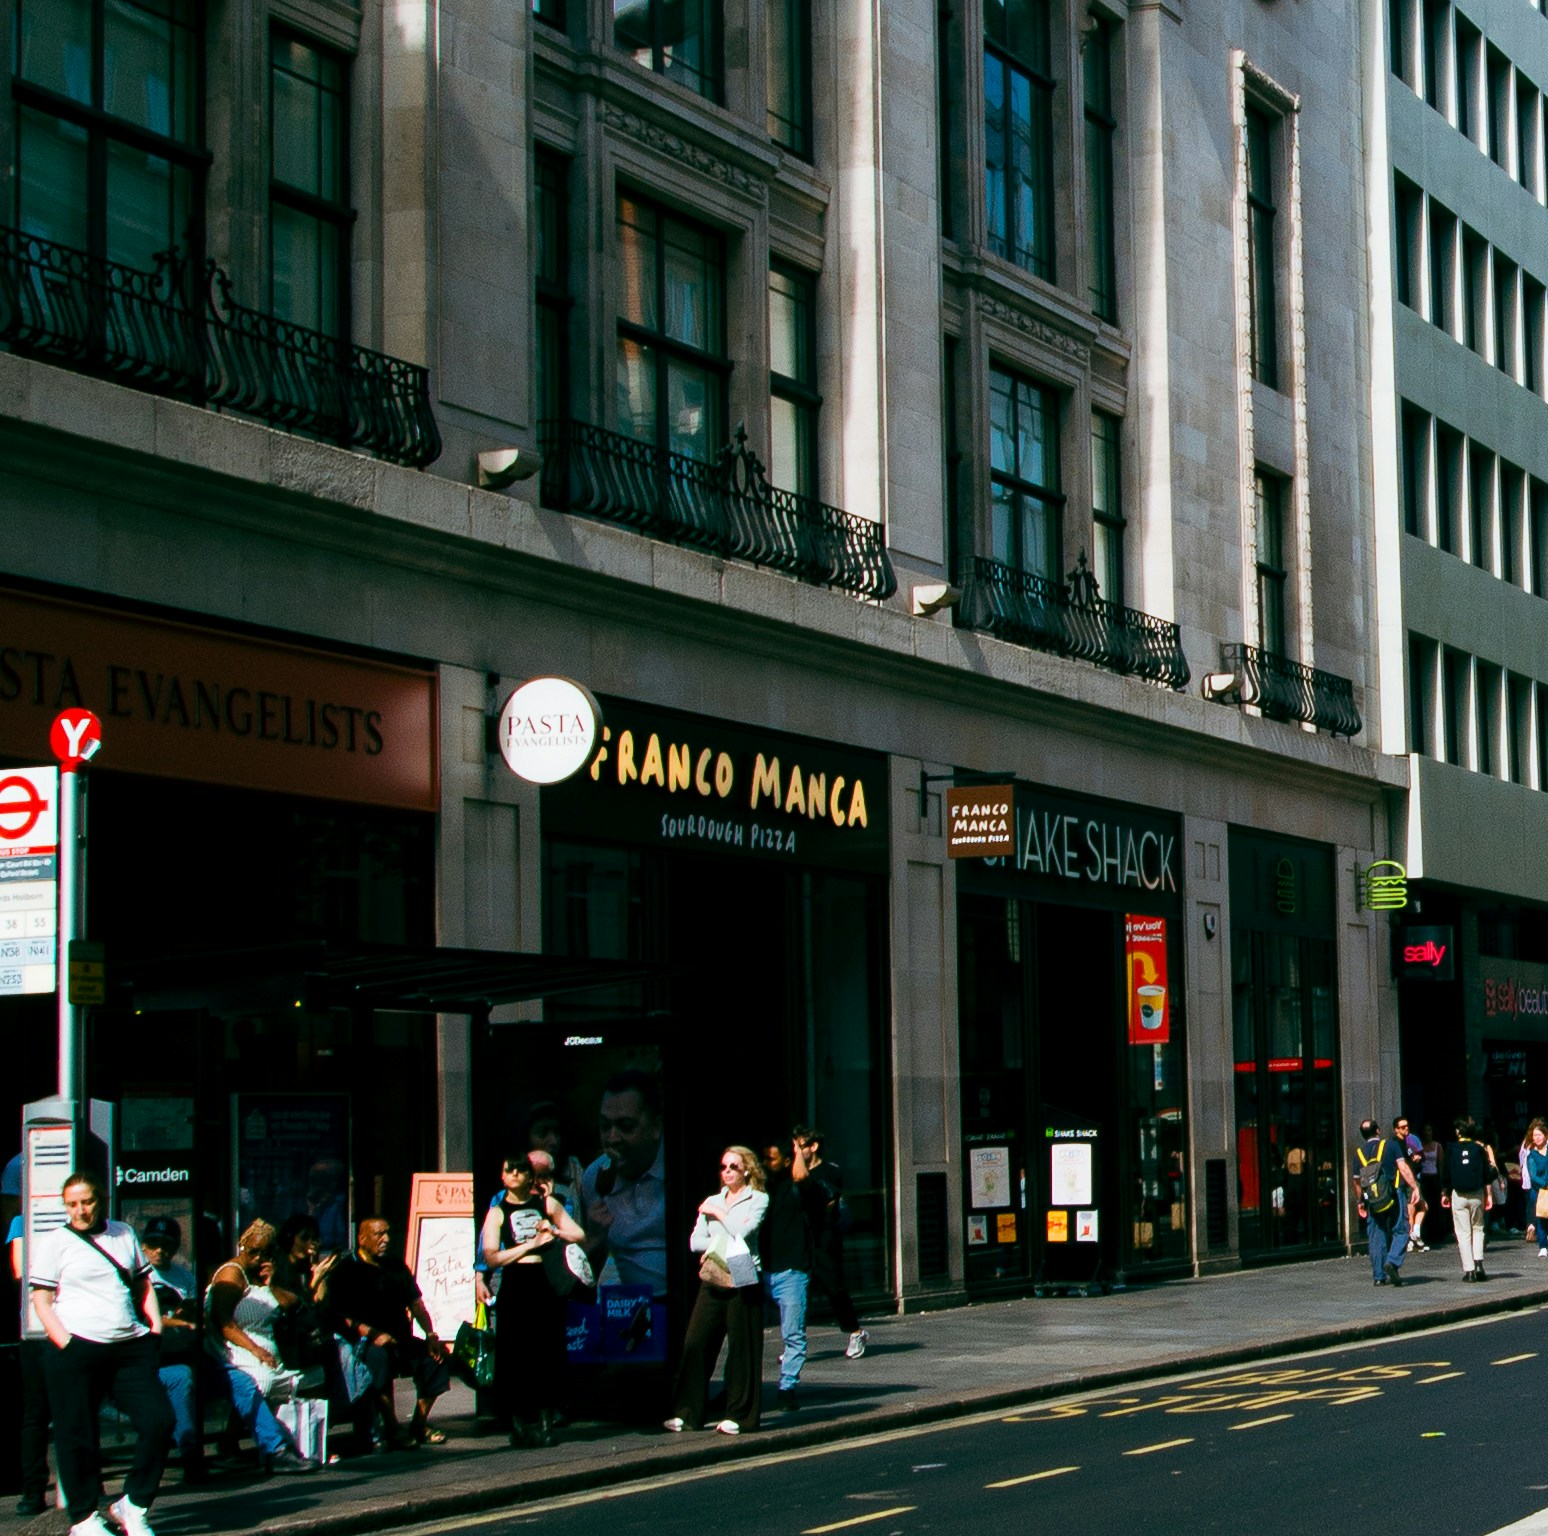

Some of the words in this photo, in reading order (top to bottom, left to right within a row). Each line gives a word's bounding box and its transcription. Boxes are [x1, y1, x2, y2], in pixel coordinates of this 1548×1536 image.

[106, 665, 385, 756] EVANGELISTS
[507, 713, 585, 737] PASTA
[60, 718, 92, 758] Y
[507, 735, 588, 748] EVANGELISTS
[750, 752, 868, 828] MANCA
[951, 803, 1009, 817] FRANCO
[661, 813, 744, 846] SOURDOUGH
[750, 824, 796, 854] PIZZA
[953, 819, 1007, 833] MANCA
[983, 807, 1080, 879] HAKE
[1086, 820, 1176, 893] SHACK
[6, 919, 18, 930] 38
[34, 917, 46, 928] 55
[1403, 940, 1446, 966] sally
[125, 1167, 189, 1182] Camden
[424, 1255, 464, 1280] Pasta
[606, 1298, 637, 1309] DAIRY
[607, 1309, 631, 1319] MILK
[1001, 1385, 1381, 1422] STOP
